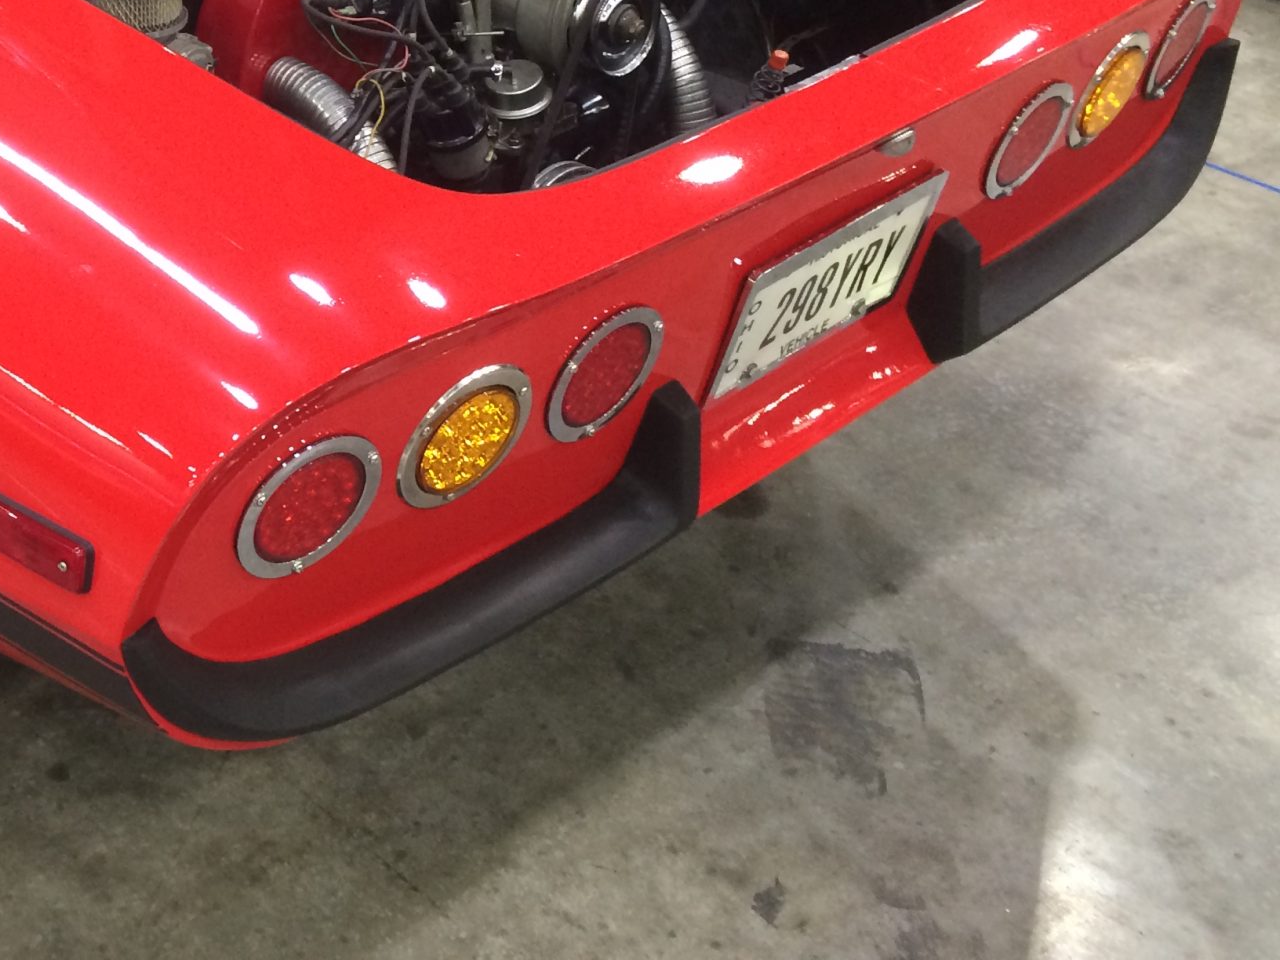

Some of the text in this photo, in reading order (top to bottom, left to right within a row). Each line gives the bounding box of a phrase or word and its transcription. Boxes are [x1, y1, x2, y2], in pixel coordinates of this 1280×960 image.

[758, 224, 907, 351] 298YRY
[724, 300, 763, 374] OHIO
[780, 318, 831, 357] VEHICLE
